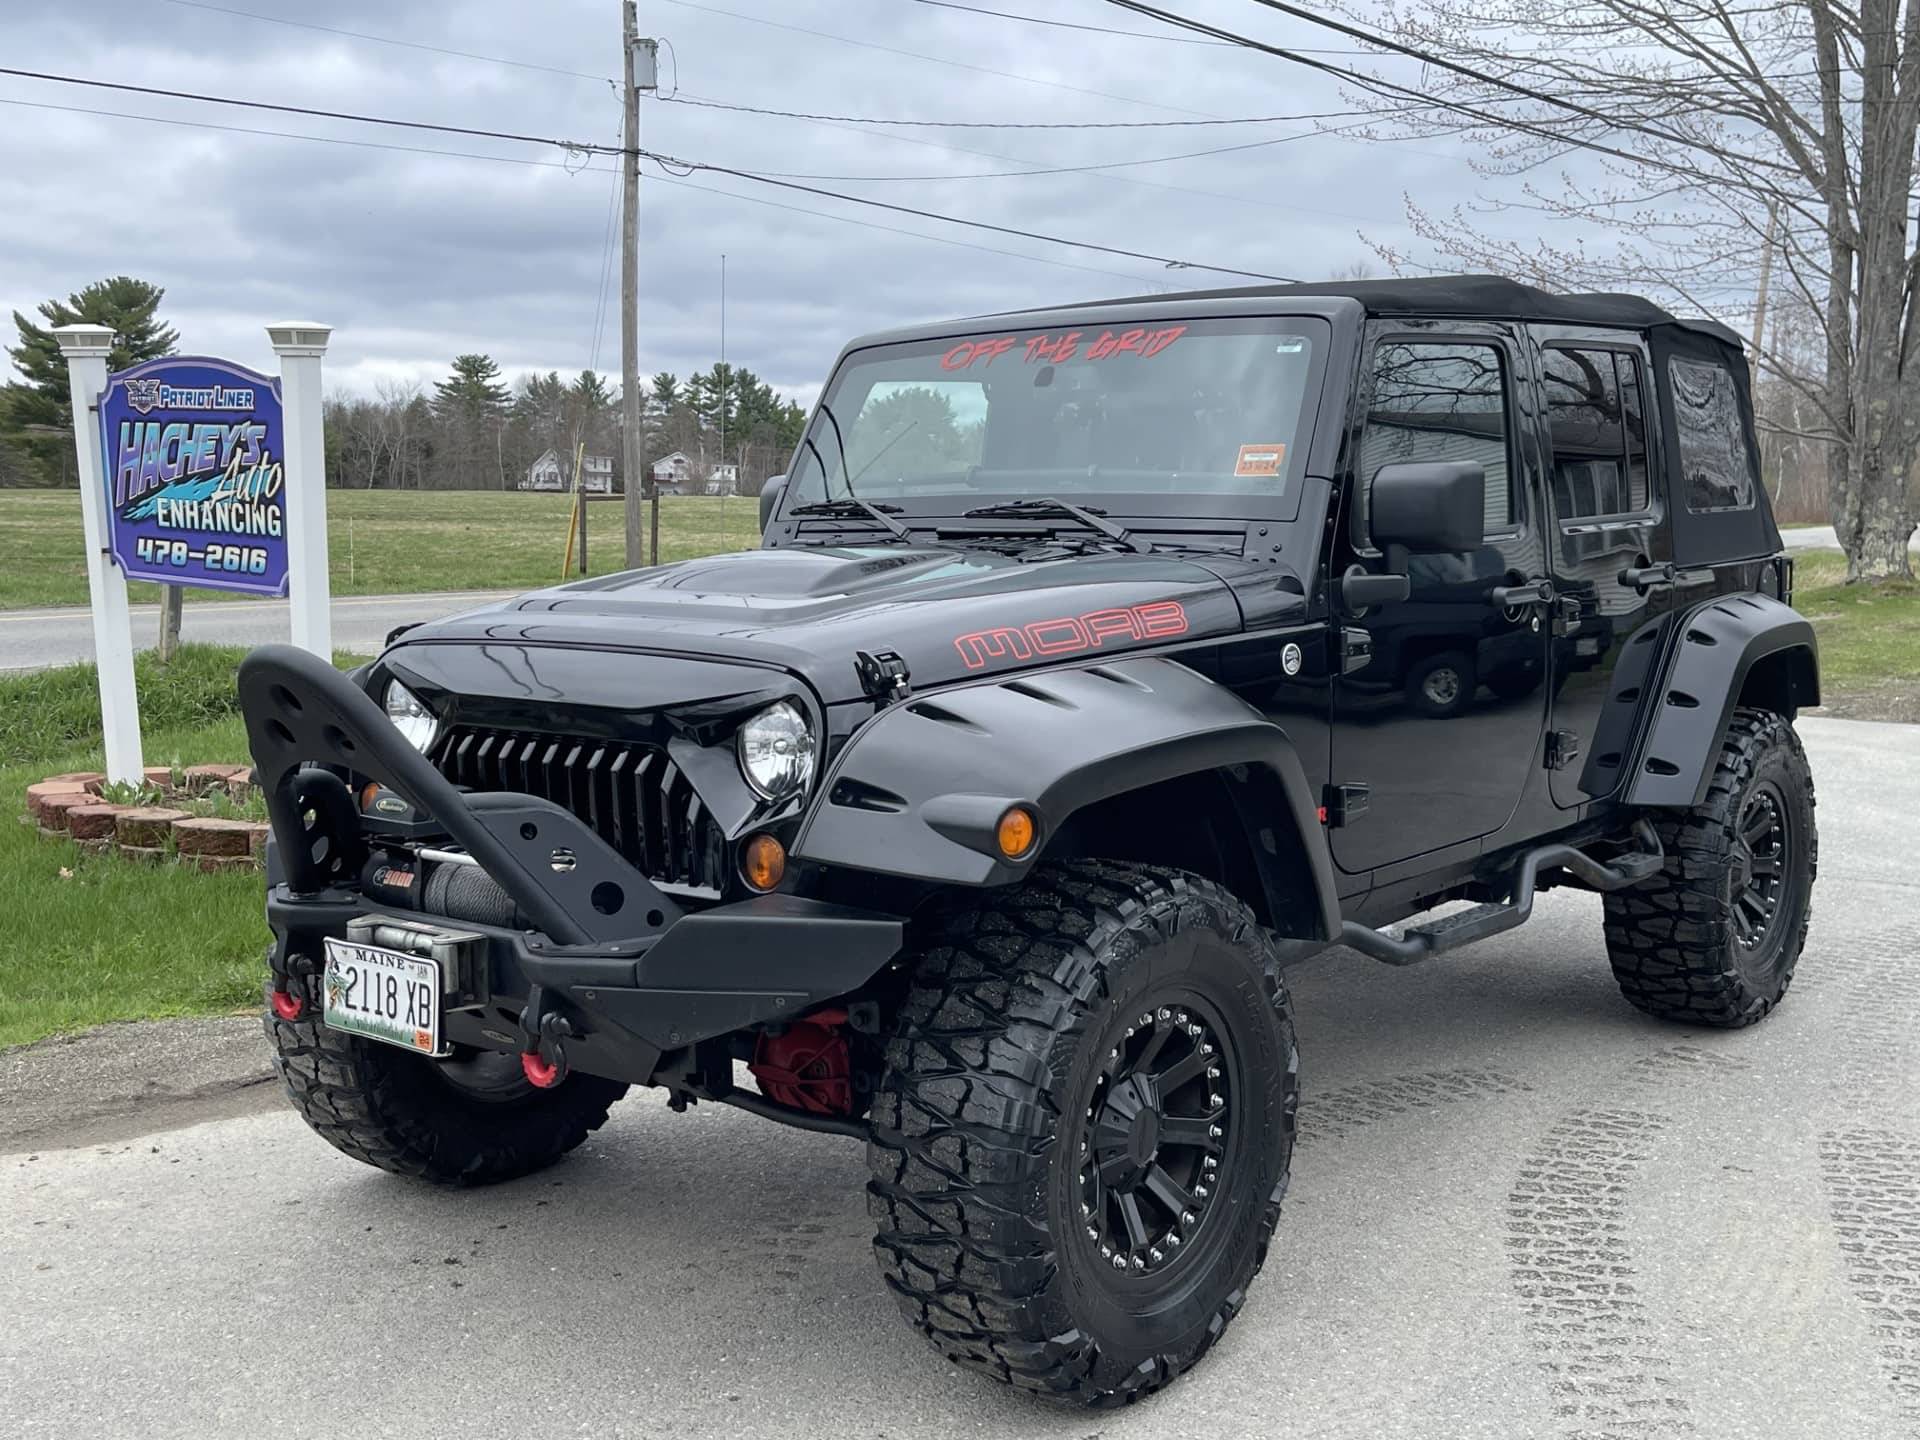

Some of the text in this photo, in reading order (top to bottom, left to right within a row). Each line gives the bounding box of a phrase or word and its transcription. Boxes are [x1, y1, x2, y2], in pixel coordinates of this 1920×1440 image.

[940, 326, 1188, 372] OFF THE GRID
[115, 420, 267, 508] HACHEY'S
[210, 447, 282, 511] Auto
[157, 498, 282, 537] ENHANCING
[137, 538, 268, 574] 478-2616
[954, 601, 1189, 670] MOAB
[356, 949, 405, 970] MAINE
[345, 966, 431, 1028] 2118 XB
